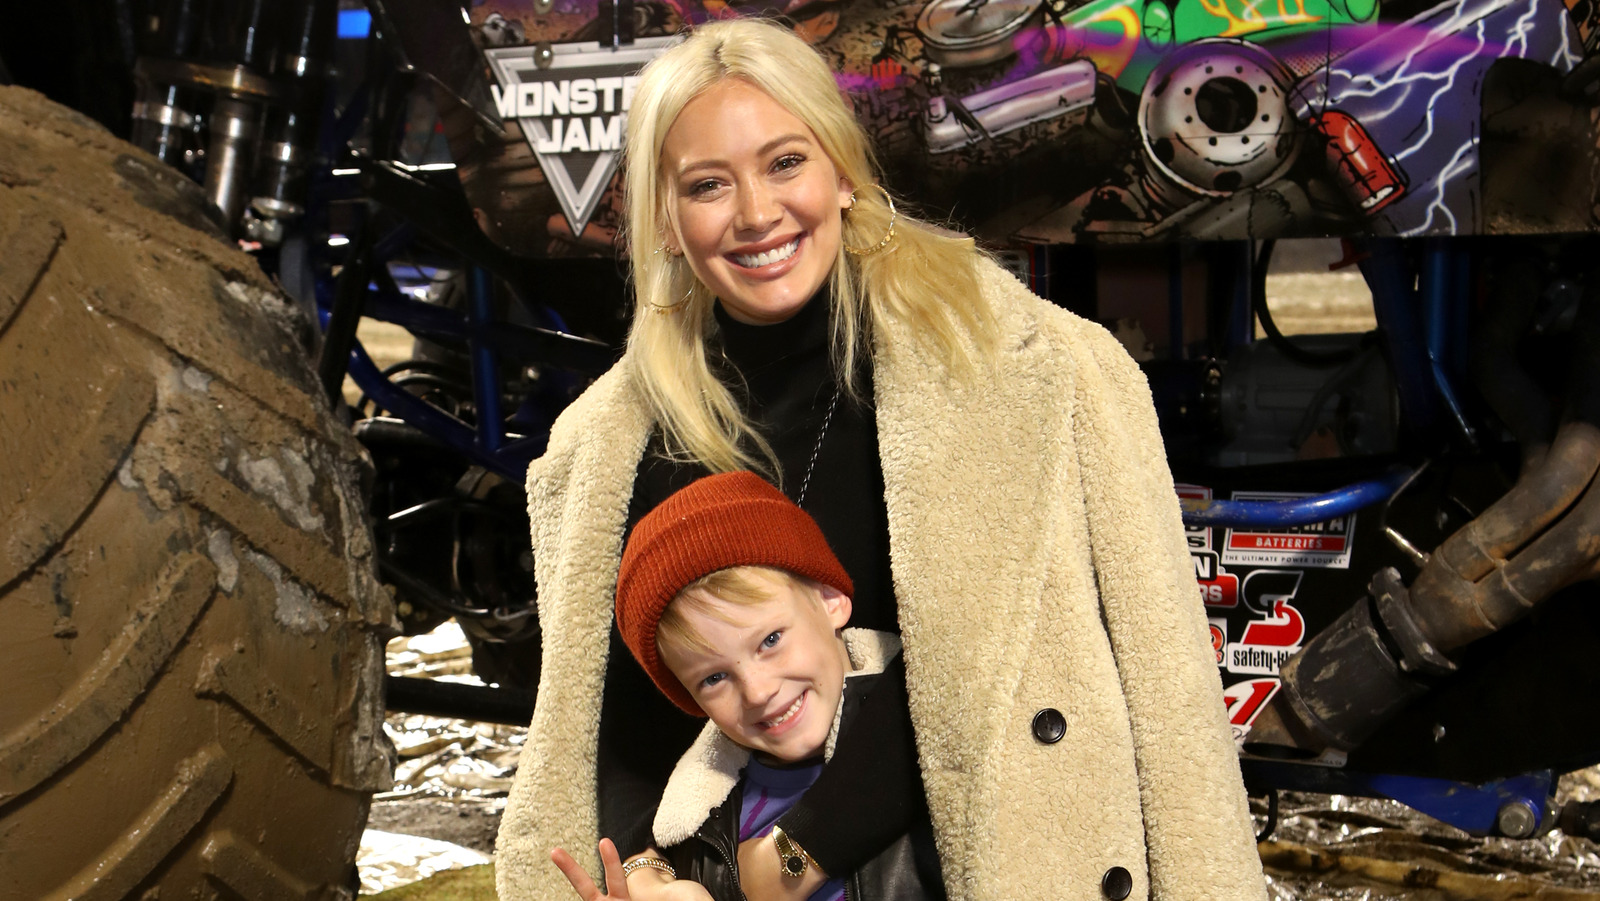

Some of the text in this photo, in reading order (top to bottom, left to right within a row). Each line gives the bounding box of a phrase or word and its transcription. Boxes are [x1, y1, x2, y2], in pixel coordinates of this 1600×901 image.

[538, 115, 621, 153] JAM
[1256, 537, 1323, 549] BATTERIES
[1242, 555, 1277, 563] ULTIMATE
